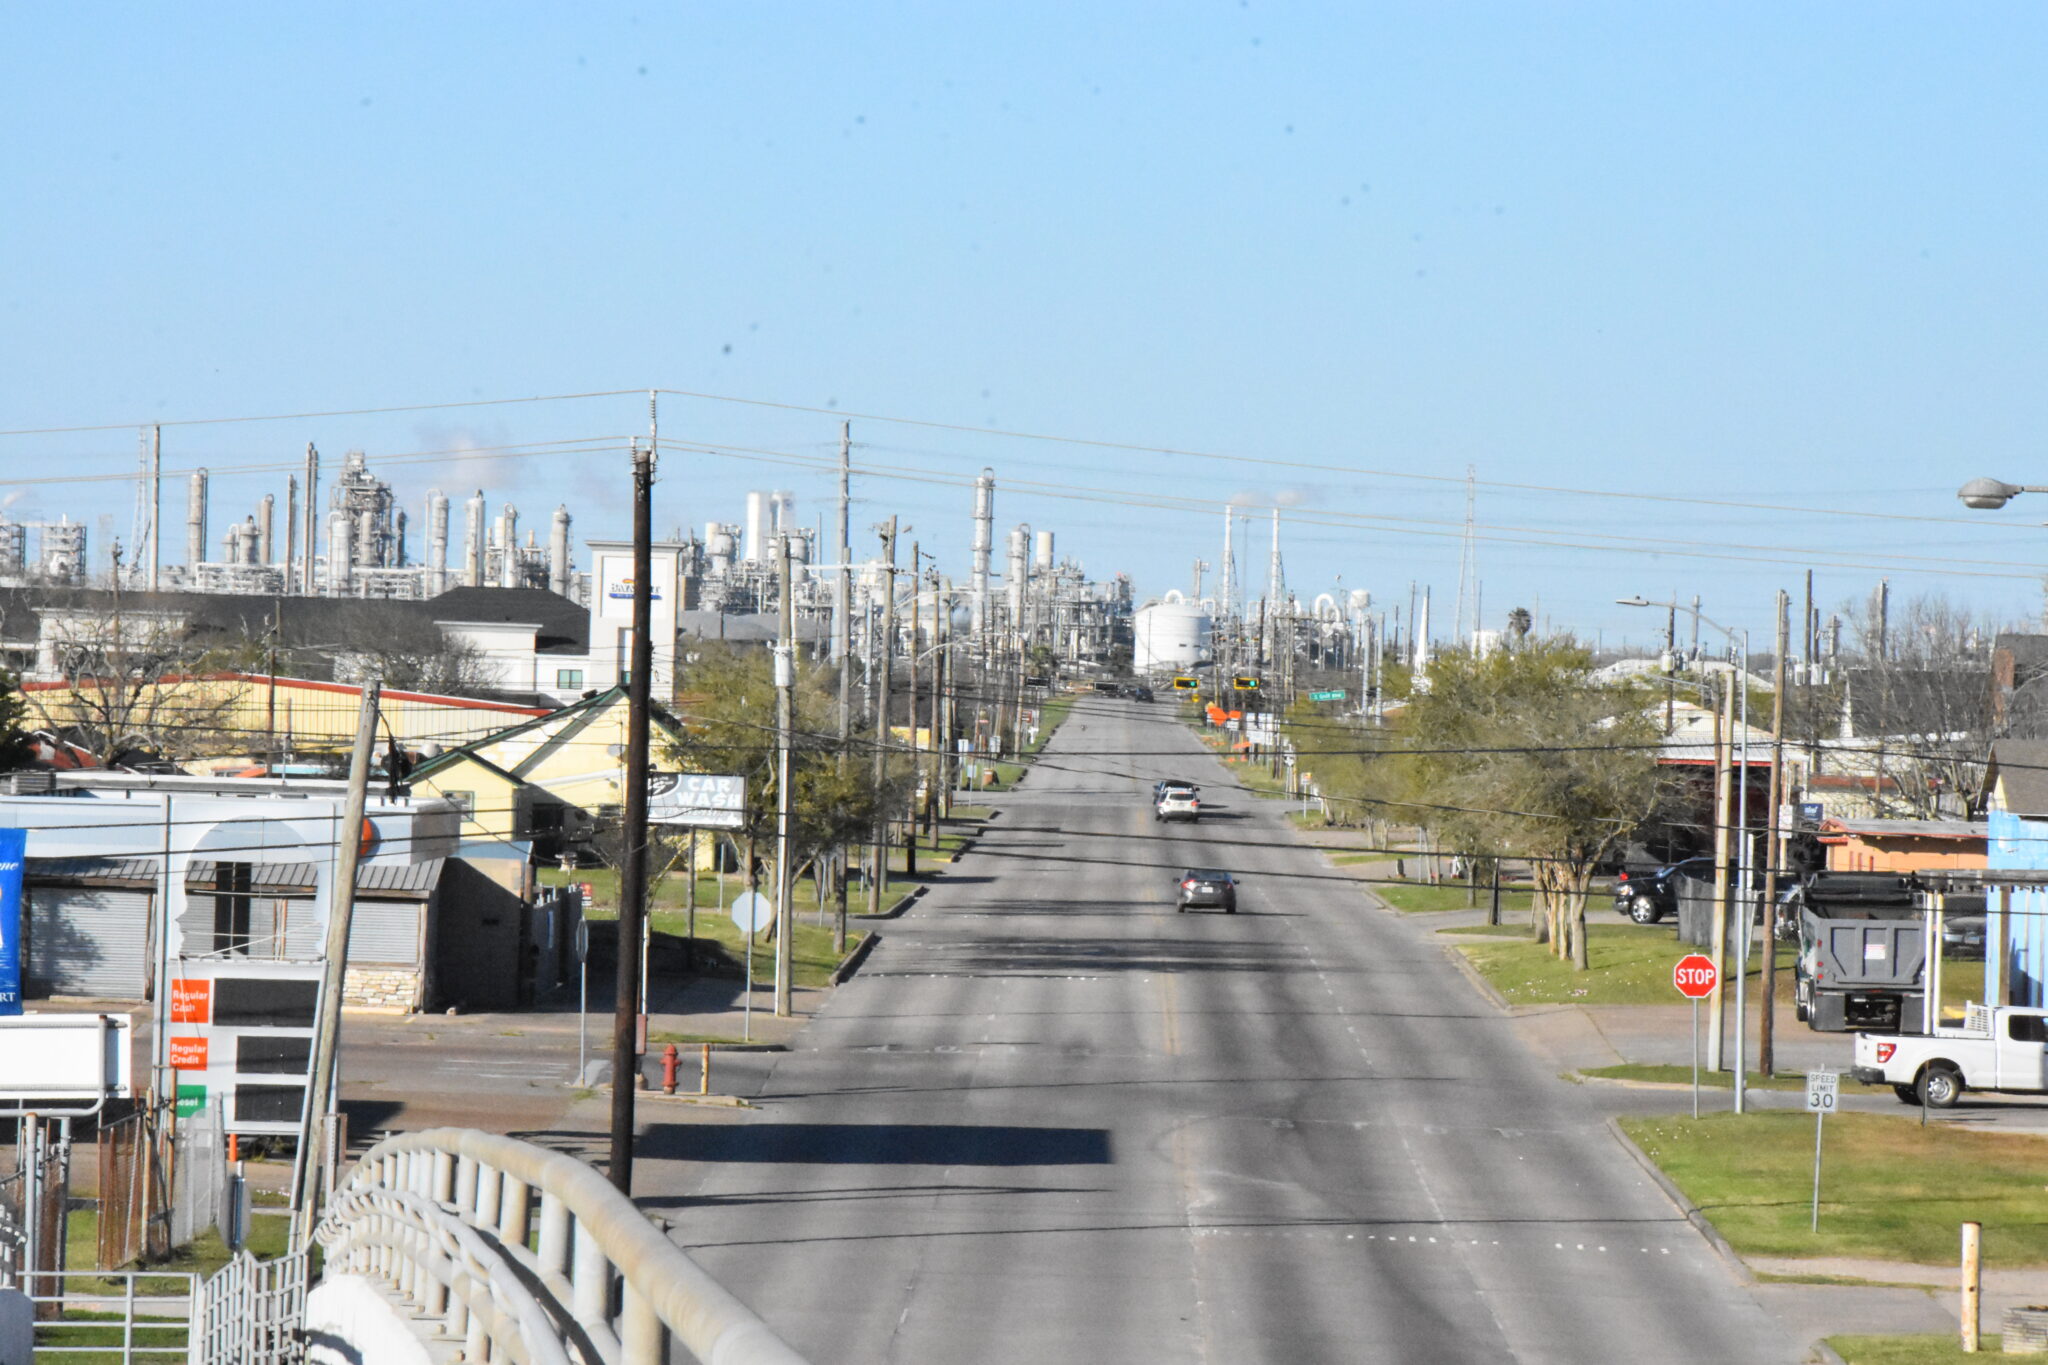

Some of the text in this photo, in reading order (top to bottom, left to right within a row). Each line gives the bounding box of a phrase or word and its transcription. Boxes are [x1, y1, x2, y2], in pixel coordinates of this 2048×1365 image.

[687, 777, 731, 792] CAR
[676, 791, 741, 808] WASH
[1677, 968, 1715, 985] STOP
[172, 990, 208, 1002] Regular
[172, 1002, 195, 1012] Cash
[171, 1043, 207, 1055] Regular
[171, 1055, 199, 1064] Credit
[1810, 1074, 1836, 1084] SPEED
[1811, 1084, 1834, 1092] LIMIT
[1810, 1093, 1833, 1108] 30
